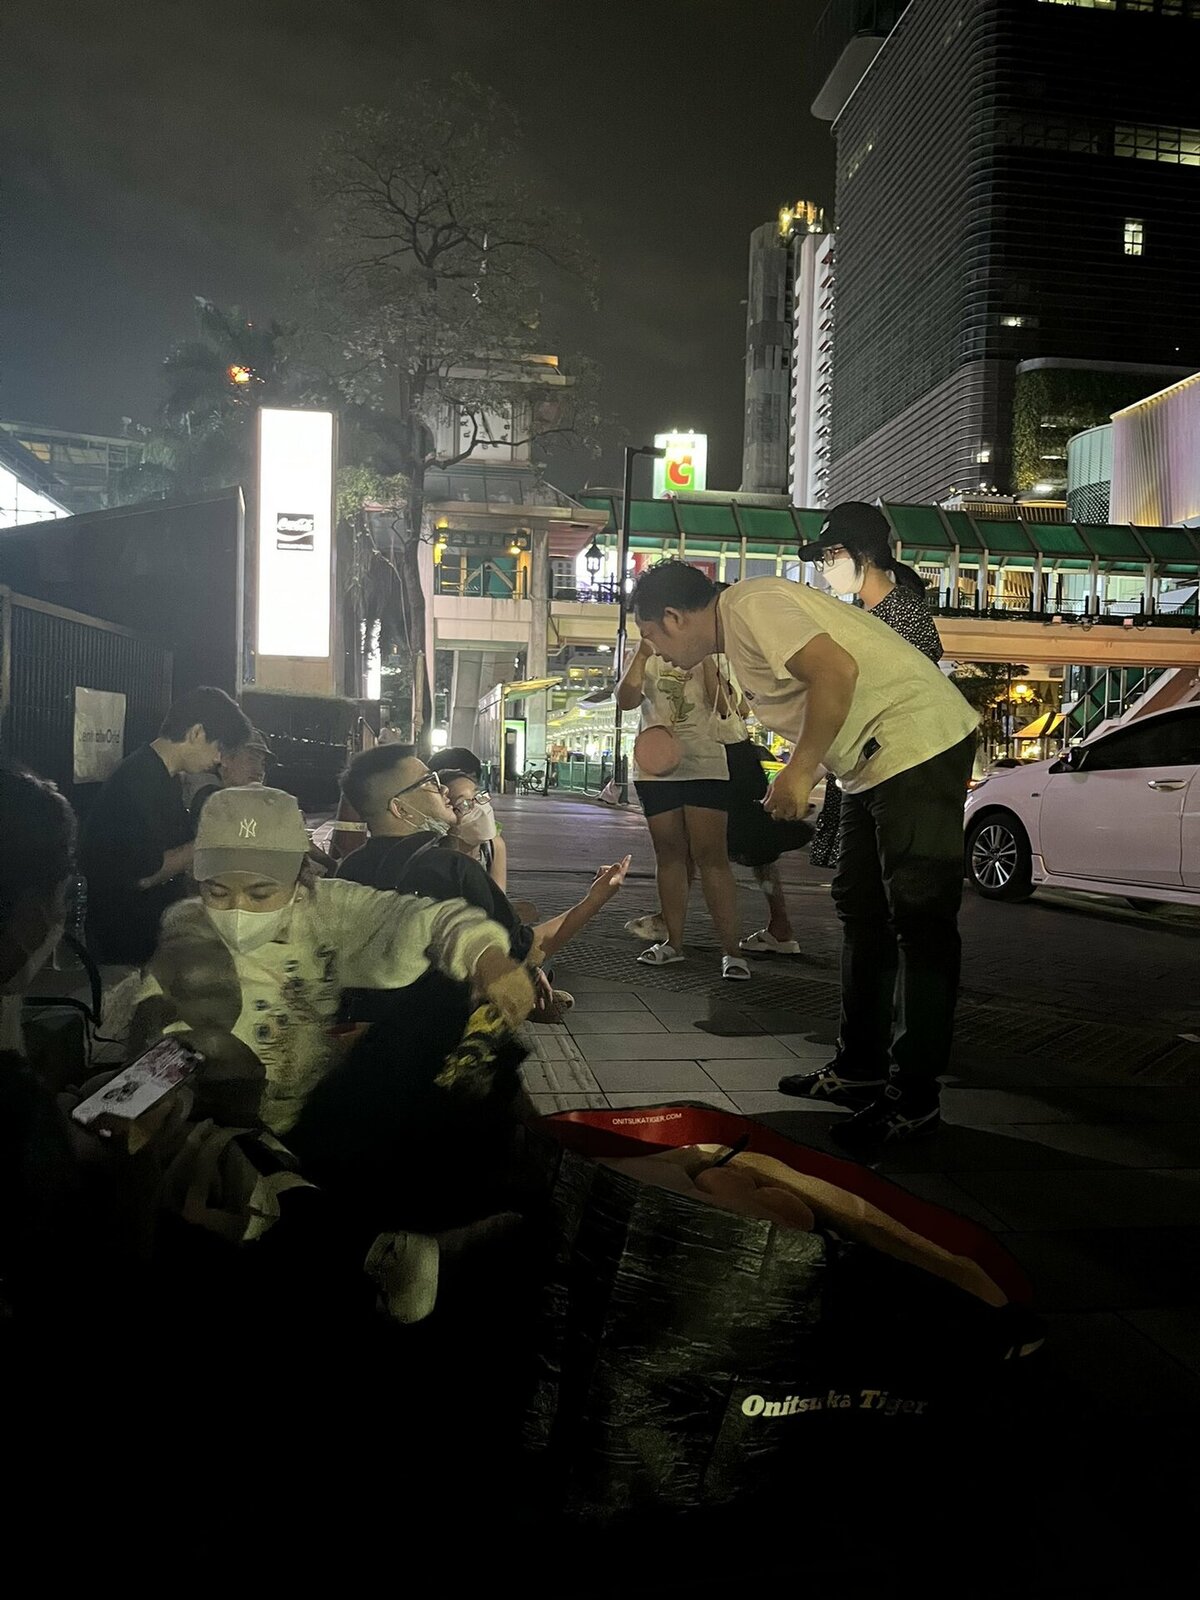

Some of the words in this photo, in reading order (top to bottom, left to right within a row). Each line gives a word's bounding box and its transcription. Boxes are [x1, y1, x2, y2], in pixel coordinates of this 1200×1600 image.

[612, 1113, 682, 1125] ONITSUKATIGER.COM
[742, 1390, 851, 1417] Onitsuka
[859, 1389, 928, 1416] Tiger
